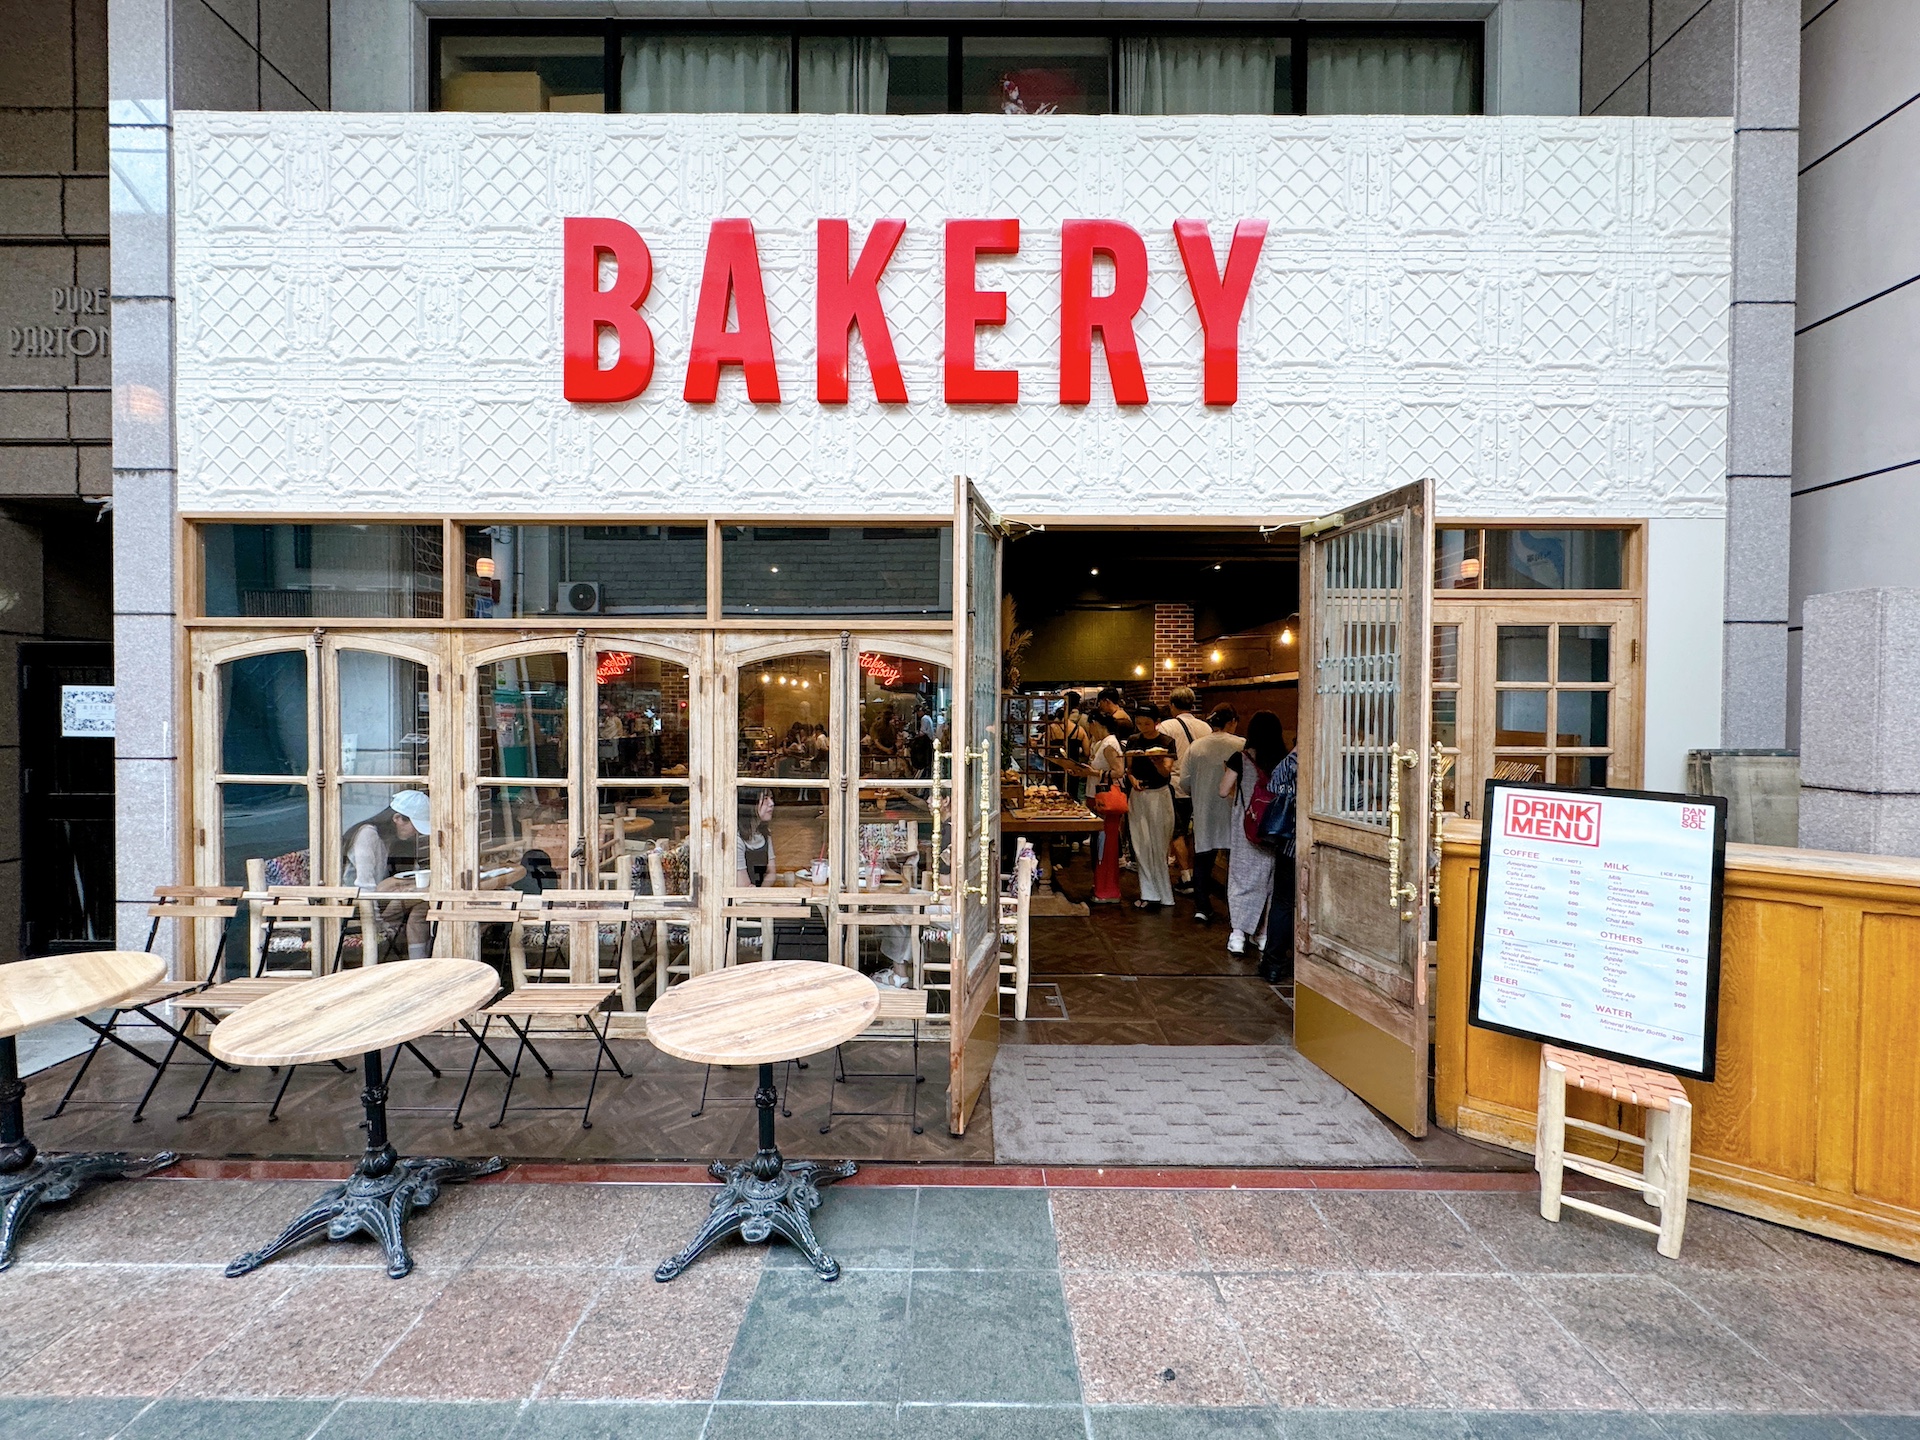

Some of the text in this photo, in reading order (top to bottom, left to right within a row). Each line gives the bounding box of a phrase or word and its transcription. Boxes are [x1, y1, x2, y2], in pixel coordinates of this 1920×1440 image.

[52, 287, 108, 314] PURE
[564, 217, 1270, 405] BAKERY
[859, 653, 886, 668] take
[868, 668, 901, 686] away
[1512, 799, 1595, 824] DRINK
[1682, 807, 1707, 816] PAN
[1682, 813, 1706, 823] DEL
[1511, 817, 1593, 842] MENU
[1681, 820, 1706, 830] SOL
[1503, 848, 1540, 859] COFFEE
[1603, 862, 1630, 872] MILK
[1497, 927, 1515, 937] TEA
[1600, 931, 1643, 945] OTHERS
[1493, 975, 1518, 986] BEER
[1595, 1004, 1633, 1019] WATER
